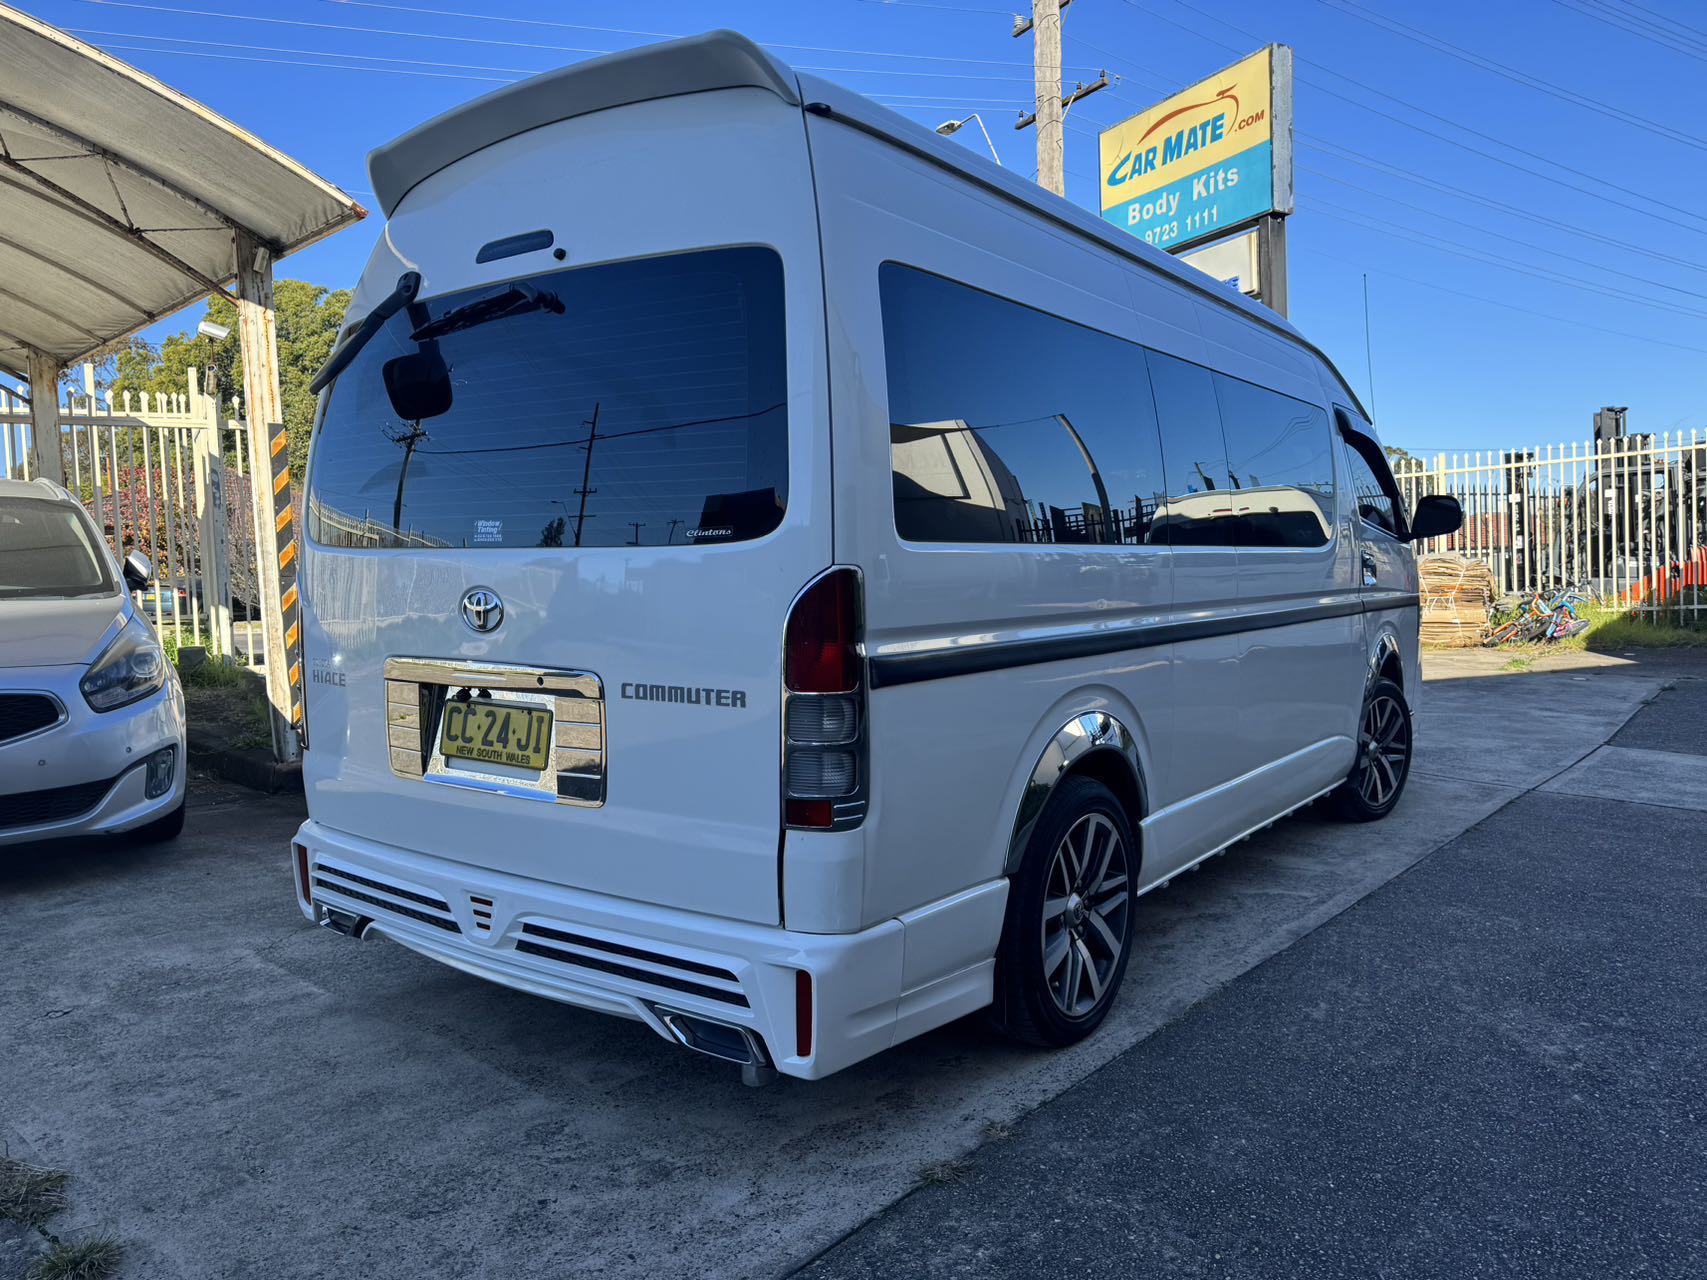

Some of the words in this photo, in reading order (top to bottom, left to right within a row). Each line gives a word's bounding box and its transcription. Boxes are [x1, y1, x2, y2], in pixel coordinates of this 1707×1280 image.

[1106, 145, 1158, 187] CAR
[1161, 112, 1226, 166] MATE
[1127, 190, 1181, 226] Body
[1192, 167, 1239, 201] Kits
[1145, 222, 1178, 245] 9723
[1185, 205, 1218, 233] 1111
[686, 529, 732, 537] Clintons
[312, 669, 346, 688] HIACE
[621, 682, 747, 709] COMMUTER
[456, 744, 474, 756] NEW
[476, 747, 503, 761] SOUTH
[505, 751, 531, 765] WALES
